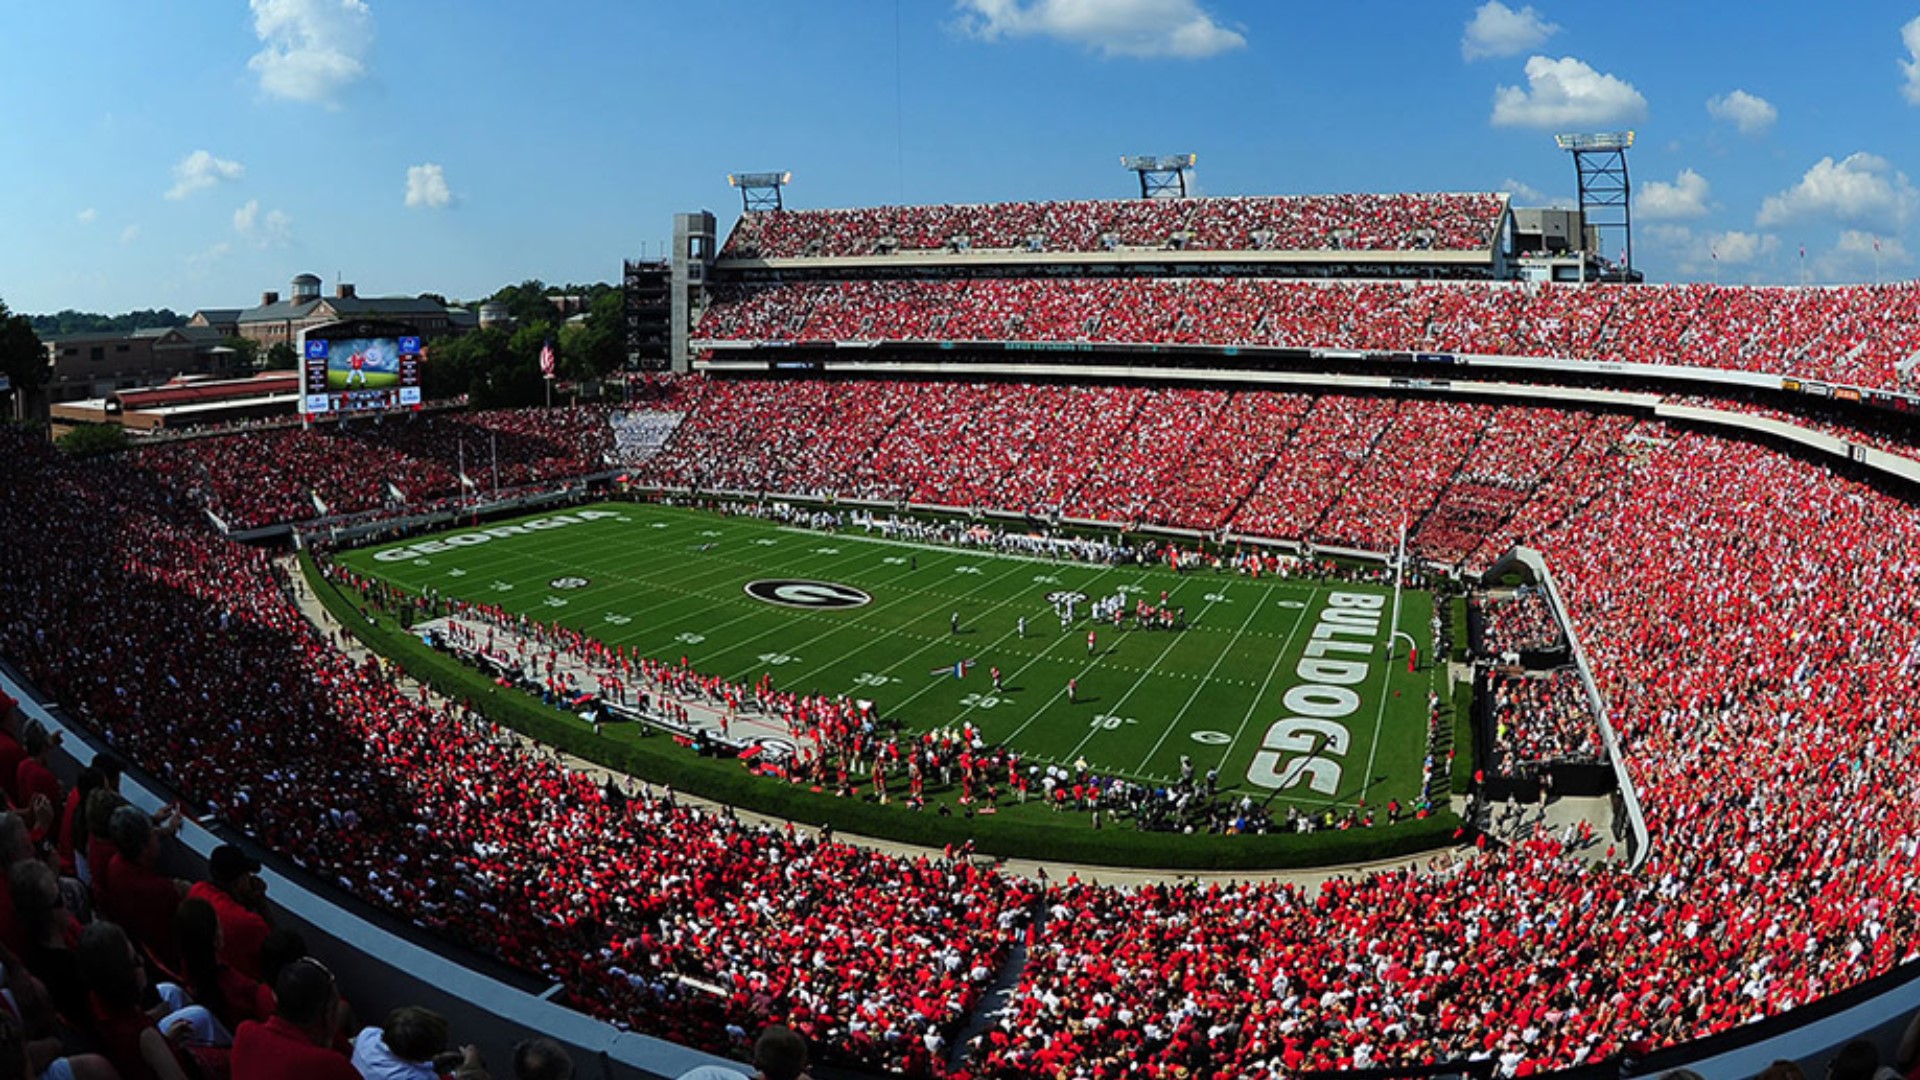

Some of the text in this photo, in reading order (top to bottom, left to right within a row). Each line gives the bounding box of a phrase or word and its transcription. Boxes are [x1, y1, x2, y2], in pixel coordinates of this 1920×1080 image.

[373, 510, 621, 561] GEORGIA
[768, 582, 872, 605] G
[853, 672, 889, 687] 30
[959, 693, 1000, 708] 20
[1246, 591, 1386, 796] BULLDOGS
[1089, 713, 1123, 730] 10
